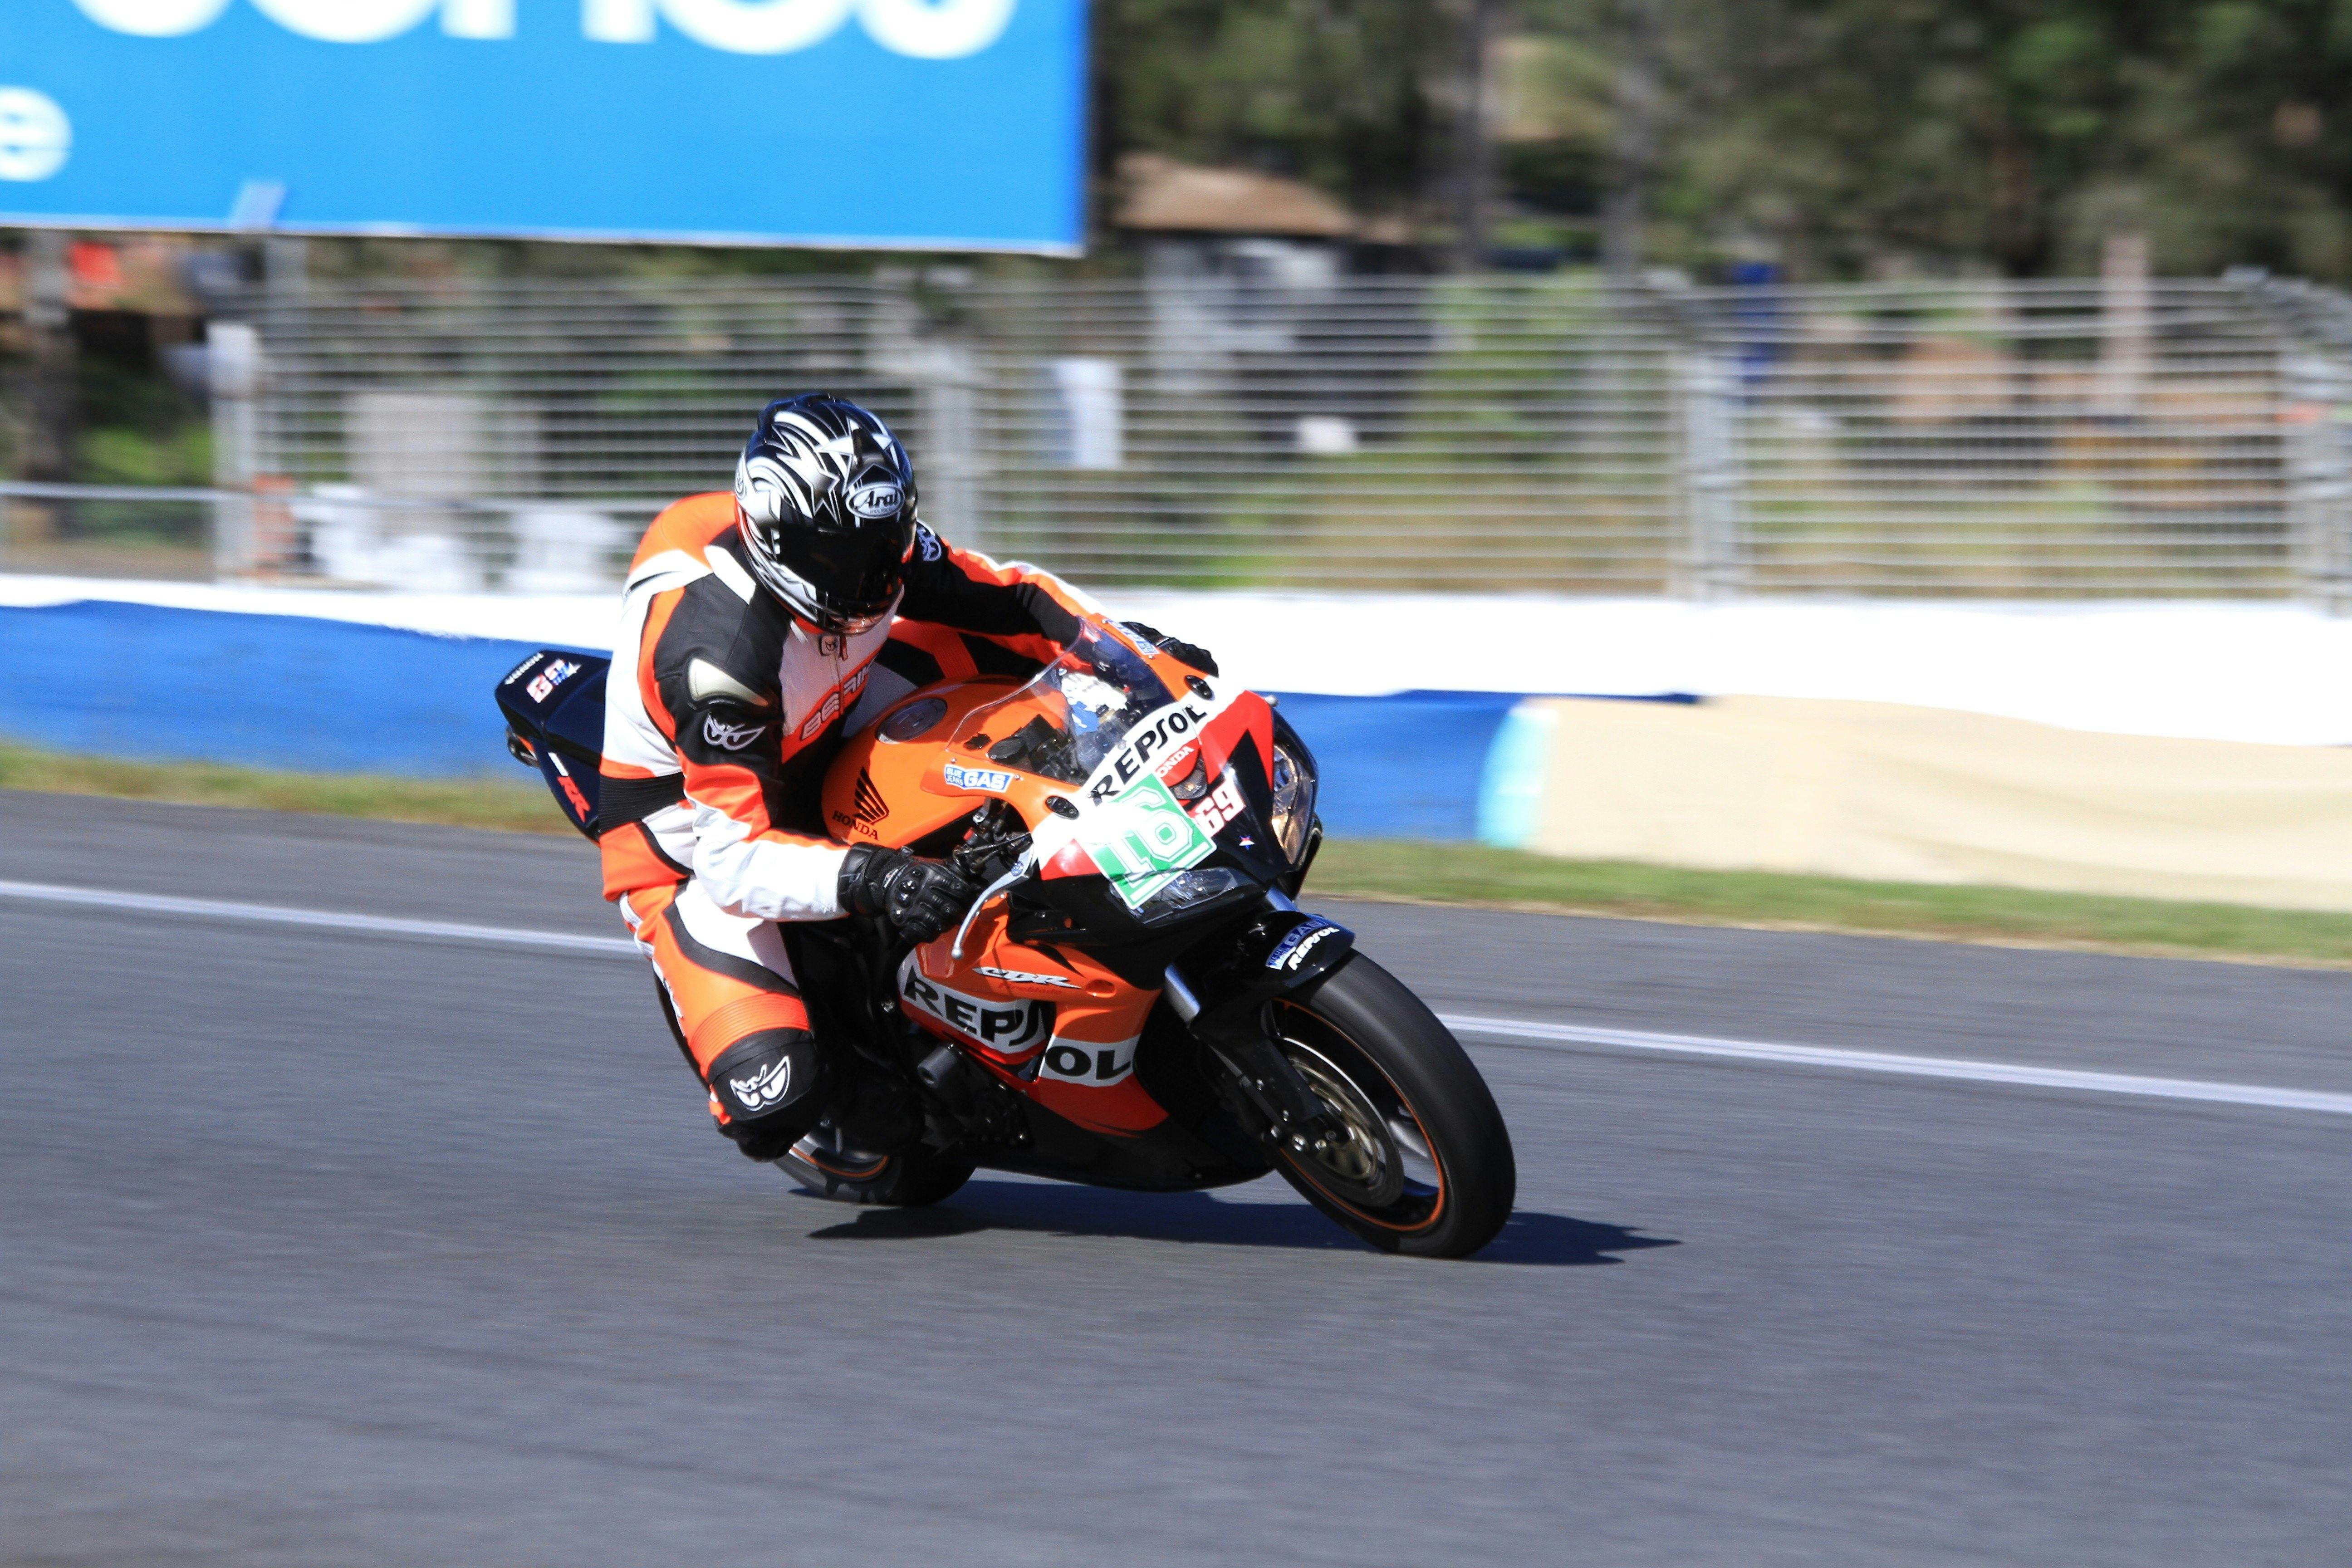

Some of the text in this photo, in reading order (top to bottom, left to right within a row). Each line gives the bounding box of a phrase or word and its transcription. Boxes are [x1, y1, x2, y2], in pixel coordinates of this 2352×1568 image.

[855, 490, 898, 507] Arai
[1088, 704, 1208, 807] REPSOL
[1156, 746, 1195, 778] ONDA
[946, 767, 962, 778] BLUE
[946, 775, 964, 787] JEANS
[964, 772, 1005, 790] GAS
[1192, 778, 1245, 838] 69
[832, 809, 879, 841] HONDA
[1107, 786, 1194, 888] 16
[1288, 927, 1340, 970] REPSOL
[972, 966, 1082, 989] CBR
[904, 965, 1132, 1081] REPSOL
